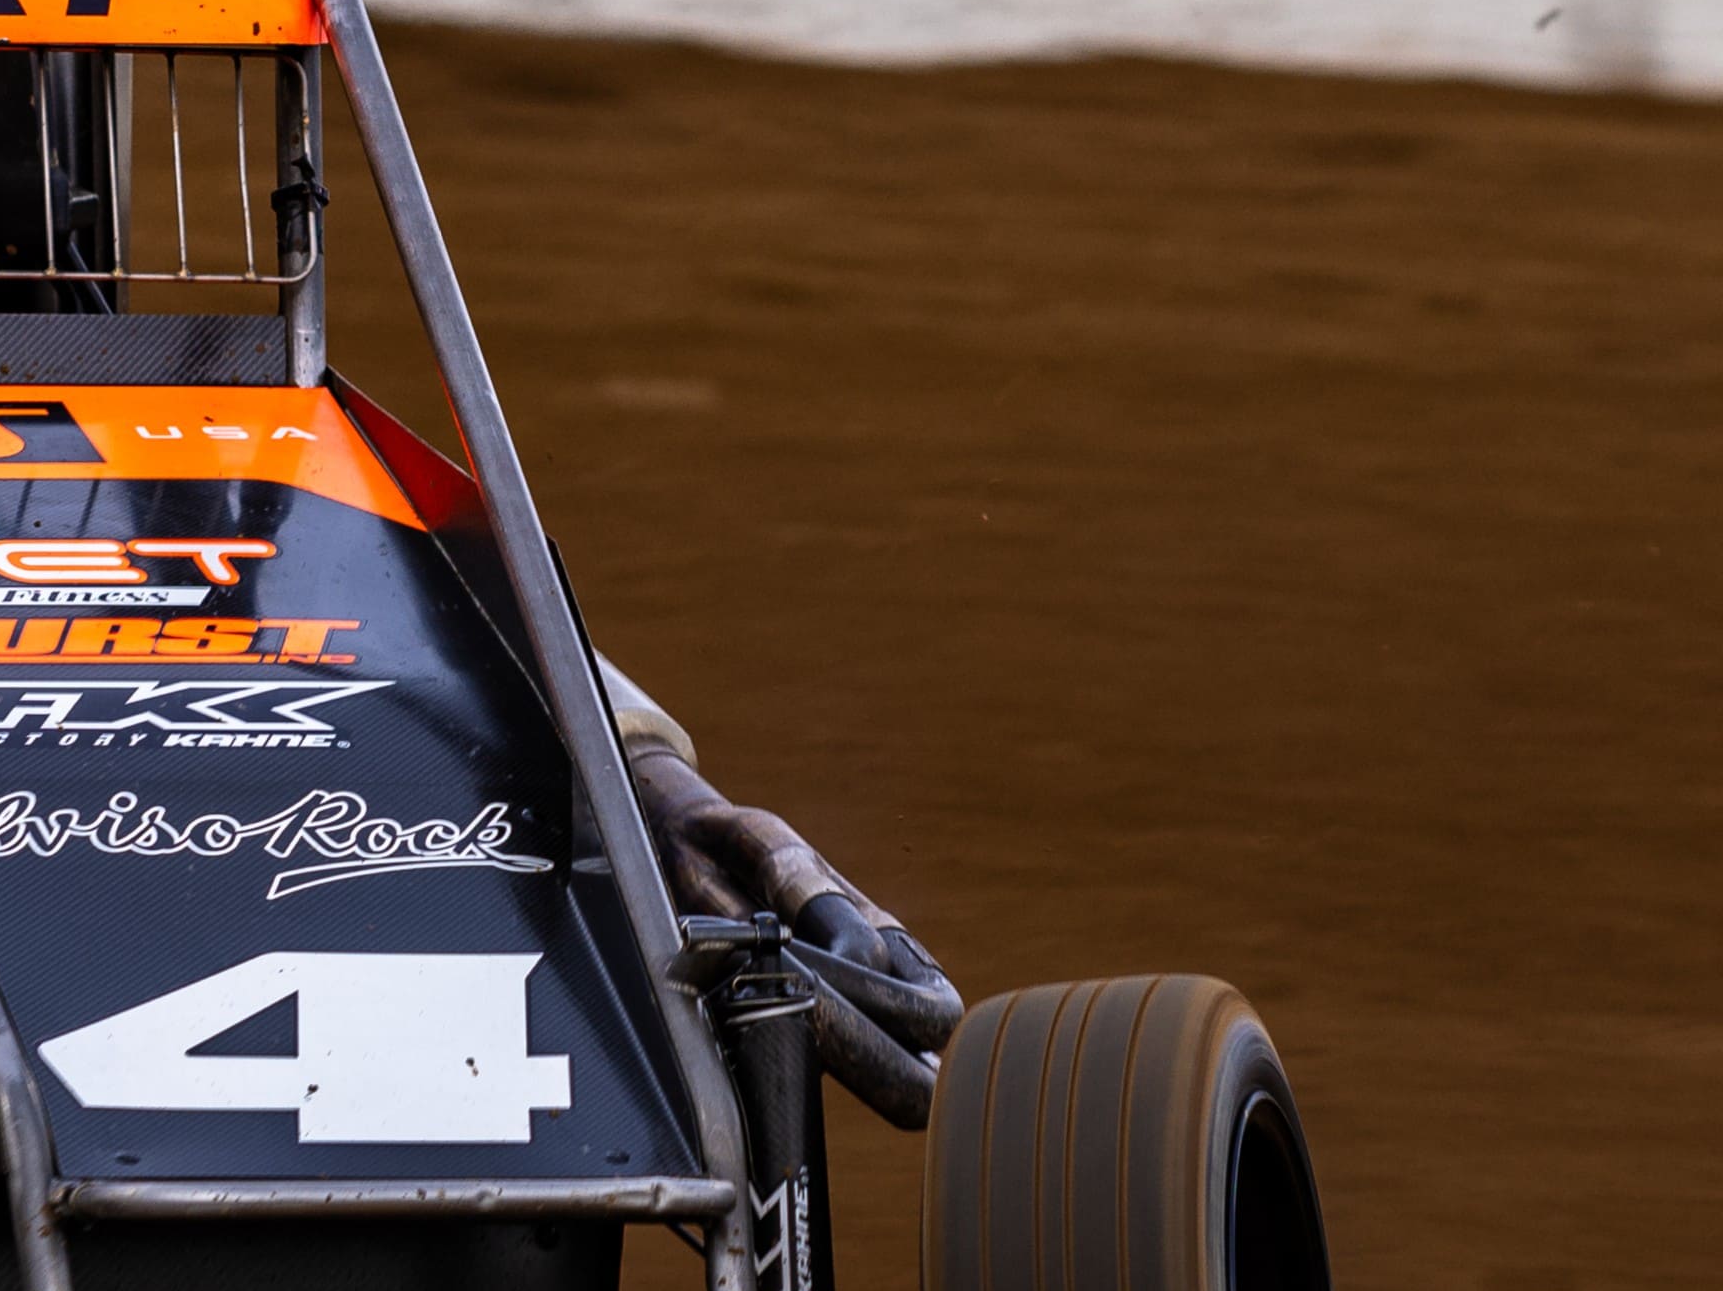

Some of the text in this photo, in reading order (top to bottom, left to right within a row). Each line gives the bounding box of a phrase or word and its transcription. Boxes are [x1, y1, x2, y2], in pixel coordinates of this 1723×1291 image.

[135, 426, 318, 441] USA
[1, 589, 169, 604] Fitness
[39, 952, 570, 1143] 4
